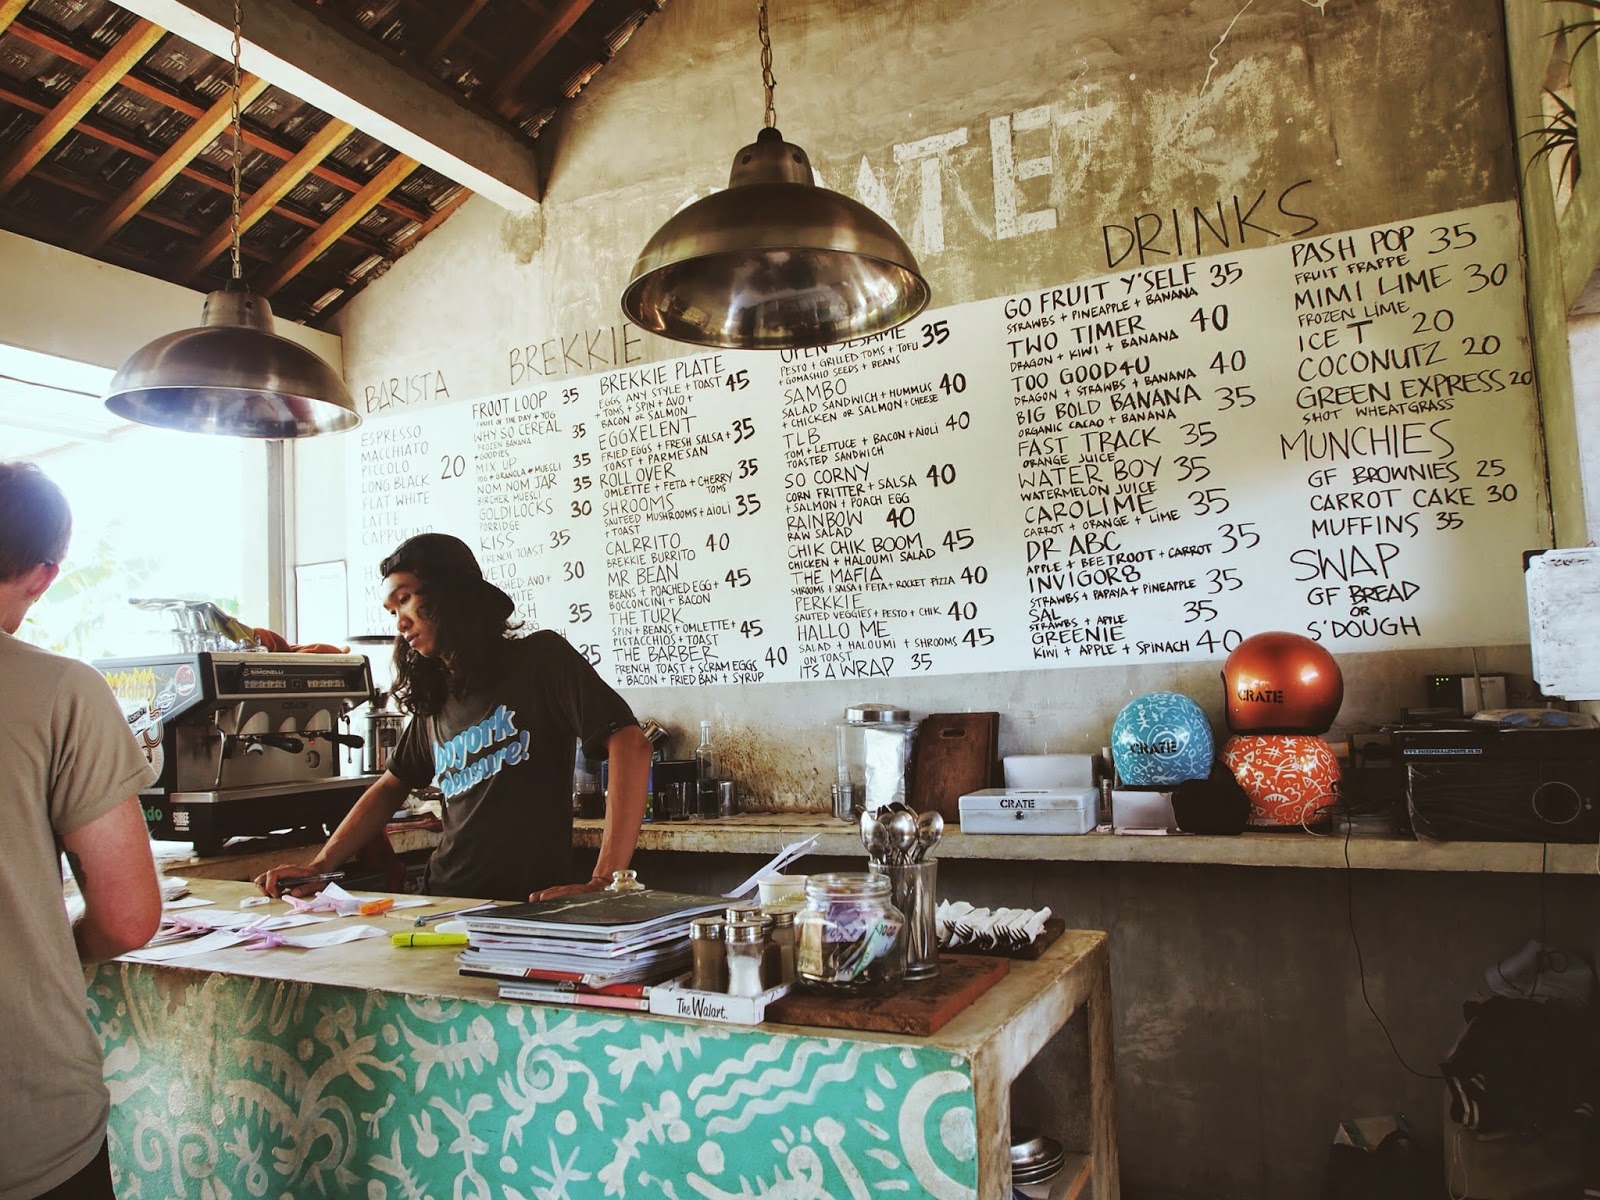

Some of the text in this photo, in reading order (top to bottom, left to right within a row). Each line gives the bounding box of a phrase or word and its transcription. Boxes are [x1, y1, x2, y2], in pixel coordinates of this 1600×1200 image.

[1103, 179, 1318, 268] DRINKS
[1292, 223, 1477, 267] PASH POP 35
[1295, 254, 1411, 285] FRUIT FRAPPE
[1004, 262, 1243, 319] GO FRUIT Y'SELF 35
[1295, 263, 1508, 310] MIMI LIME 30
[1190, 305, 1228, 332] 40
[1299, 309, 1454, 352] ICE T 20
[921, 320, 950, 348] 35
[1007, 315, 1146, 358] TWO TIMER
[510, 323, 641, 385] BREKKIE
[1209, 350, 1246, 375] 40
[1298, 335, 1500, 382] COCONUTZ 20
[600, 355, 725, 395] BREKKIE PLATE
[725, 369, 750, 391] 45
[939, 373, 966, 396] 40
[1011, 356, 1150, 392] TOO GOOD4U
[365, 370, 449, 413] BARISTA
[784, 378, 847, 405] SAMBO
[1296, 369, 1532, 409] GREEN EXPRESS 20
[472, 388, 579, 419] FROOT LOOP 35
[1016, 384, 1256, 425] BIG BOLD BANANA 35
[1303, 399, 1455, 425] SHOT WHEATGRASS
[474, 420, 586, 442] WHY SO CEREAL 35
[598, 416, 697, 450] EGGXELENT
[732, 418, 755, 444] 35
[946, 411, 970, 431] 40
[361, 425, 422, 446] ESPRESSO
[783, 428, 821, 448] TLB
[1019, 421, 1217, 457] FAST TRACK 35
[1280, 419, 1454, 461] MUNCHIES
[361, 441, 428, 462] MACCHIATO
[787, 446, 884, 468] TOASTED SANDWICH
[362, 460, 409, 477] PICCOLO
[441, 455, 465, 479] 20
[600, 463, 675, 488] ROLL OVER
[738, 458, 758, 479] 35
[785, 462, 869, 489] SO CORNY
[926, 463, 956, 487] 40
[1018, 456, 1210, 488] WATER BOY 35
[1308, 459, 1506, 488] GF BROWNIES 25
[362, 474, 429, 493] LONG BLACK
[1020, 481, 1158, 502] WATERMELON JUICE
[480, 498, 592, 520] GOLDILOCKS 30
[602, 493, 674, 517] SHROOMS
[735, 493, 761, 516] 35
[1025, 488, 1230, 524] CAROLIME 35
[1310, 484, 1518, 511] CARROT CAKE 30
[480, 521, 520, 532] PORRIDGE
[787, 507, 915, 531] RAINBOW 40
[1312, 512, 1463, 539] MUFFINS 35
[480, 529, 570, 551] KISS 35
[606, 533, 729, 556] CALRRITO 40
[787, 527, 853, 542] RAW SALAD
[788, 529, 974, 559] CHIK CHIK BOOM 45
[1218, 523, 1260, 554] 35
[606, 549, 696, 568] BREKKIE BURRITO
[1026, 531, 1121, 563] DR ABC
[1290, 543, 1400, 581] SWAP
[608, 562, 679, 588] MR BEAN
[725, 568, 751, 588] 45
[791, 567, 883, 585] THE MAFIA
[960, 566, 988, 585] 40
[1029, 565, 1141, 594] INVIGOR8
[1206, 568, 1243, 595] 35
[795, 593, 864, 612] PERKKIE
[1307, 581, 1420, 605] GF BREAD
[569, 603, 592, 623] 35
[609, 608, 684, 626] THE TURK
[947, 601, 977, 621] 40
[740, 619, 763, 638] 45
[797, 621, 890, 641] HALLO ME
[962, 628, 994, 648] 45
[1032, 626, 1126, 646] GREENIE
[1307, 616, 1421, 641] S'DOUGH
[1196, 629, 1243, 653] 40
[613, 646, 719, 663] THE BARBER
[765, 646, 788, 668] 40
[800, 653, 932, 679] ITS A WRAP 35
[1238, 690, 1283, 703] CRATE
[1130, 741, 1176, 754] CRATE
[1000, 799, 1035, 809] CRATE
[676, 998, 690, 1015] The
